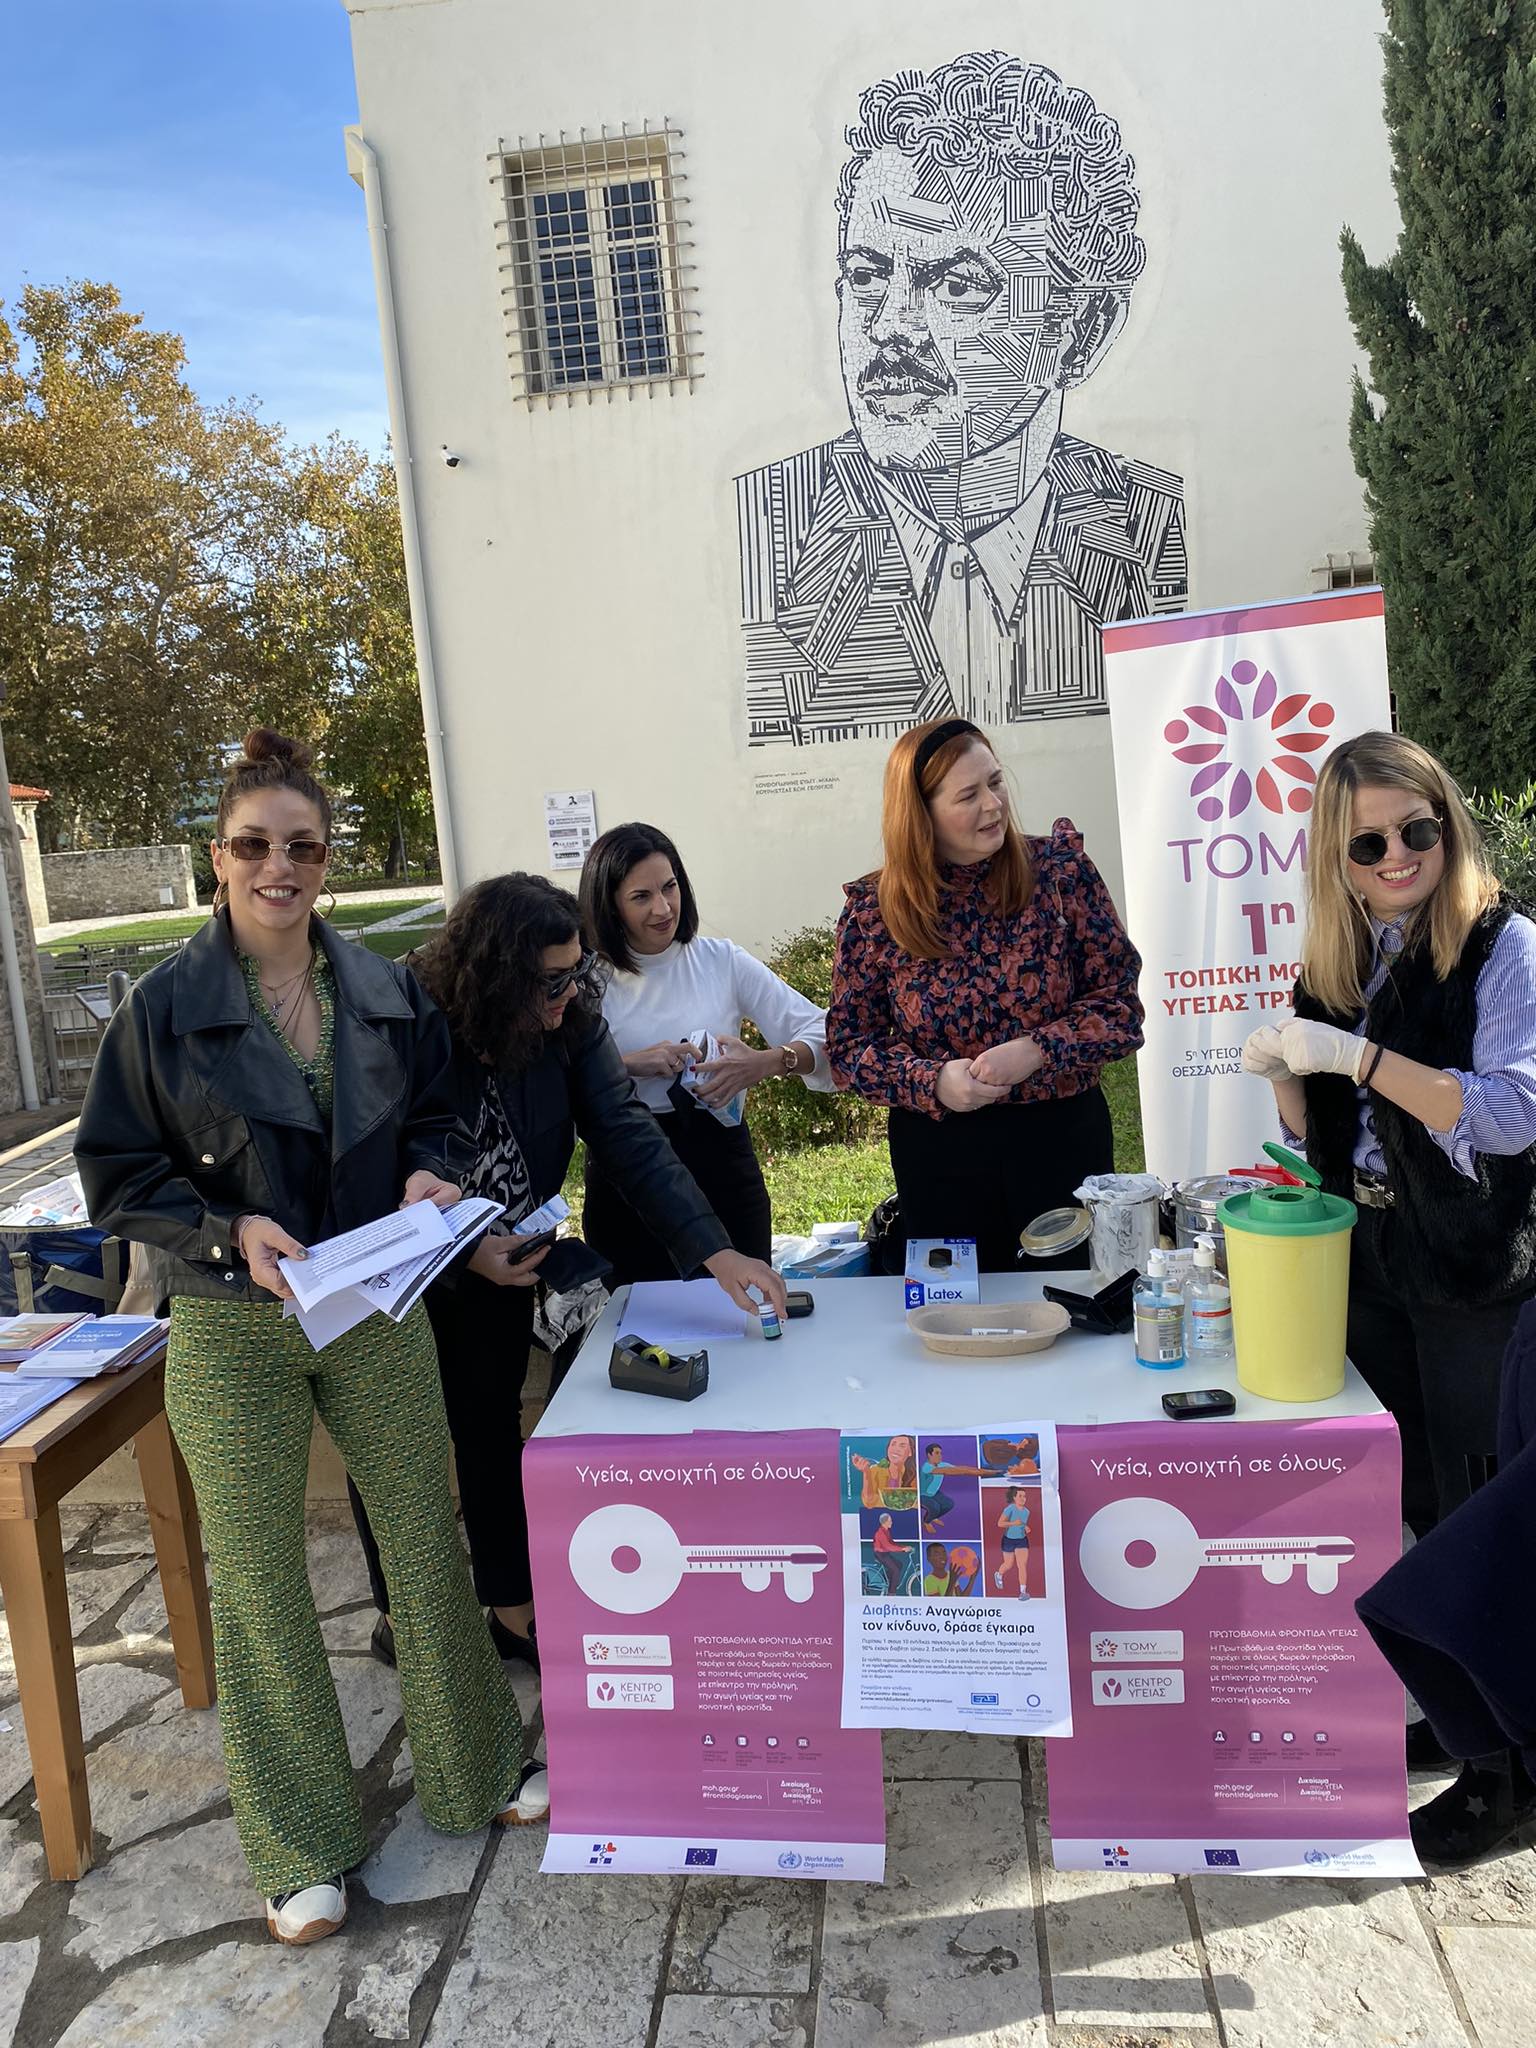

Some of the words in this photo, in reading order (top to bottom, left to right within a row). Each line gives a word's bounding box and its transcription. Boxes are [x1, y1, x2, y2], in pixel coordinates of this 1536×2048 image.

[1168, 828, 1308, 882] ΤΟΜ
[1165, 964, 1260, 989] ΤΟΠΙΚΗ
[1269, 962, 1304, 982] ΜΟ
[1162, 993, 1249, 1016] ΥΓΕΙΑΣ
[1255, 990, 1293, 1010] ΤΡΙ
[1201, 1047, 1243, 1061] ΥΓΕΙΟΝ
[1172, 1062, 1242, 1078] ΘΕΣΣΑΛΙΑΣ
[928, 1287, 963, 1300] Latex
[576, 1464, 633, 1486] Υγεία,
[639, 1463, 718, 1485] ανοιχτή
[723, 1467, 746, 1480] σε
[752, 1462, 816, 1484] όλους.
[1091, 1457, 1152, 1480] Υγεία,
[1159, 1454, 1242, 1478] ανοιχτή
[1249, 1458, 1272, 1472] σε
[1279, 1454, 1347, 1476] όλους.
[926, 1606, 1002, 1619] Αναγνώρισε
[862, 1622, 882, 1632] τον
[887, 1620, 940, 1633] κίνδυνο,
[944, 1620, 982, 1634] δράσε
[986, 1622, 1035, 1636] έγκαιρα
[620, 1682, 662, 1692] ΚΕΝΤΡΟ
[1128, 1677, 1172, 1687] ΚΕΝΤΡΟ
[621, 1693, 656, 1702] ΥΓΕΙΑΣ
[1129, 1688, 1166, 1697] ΥΓΕΙΑΣ
